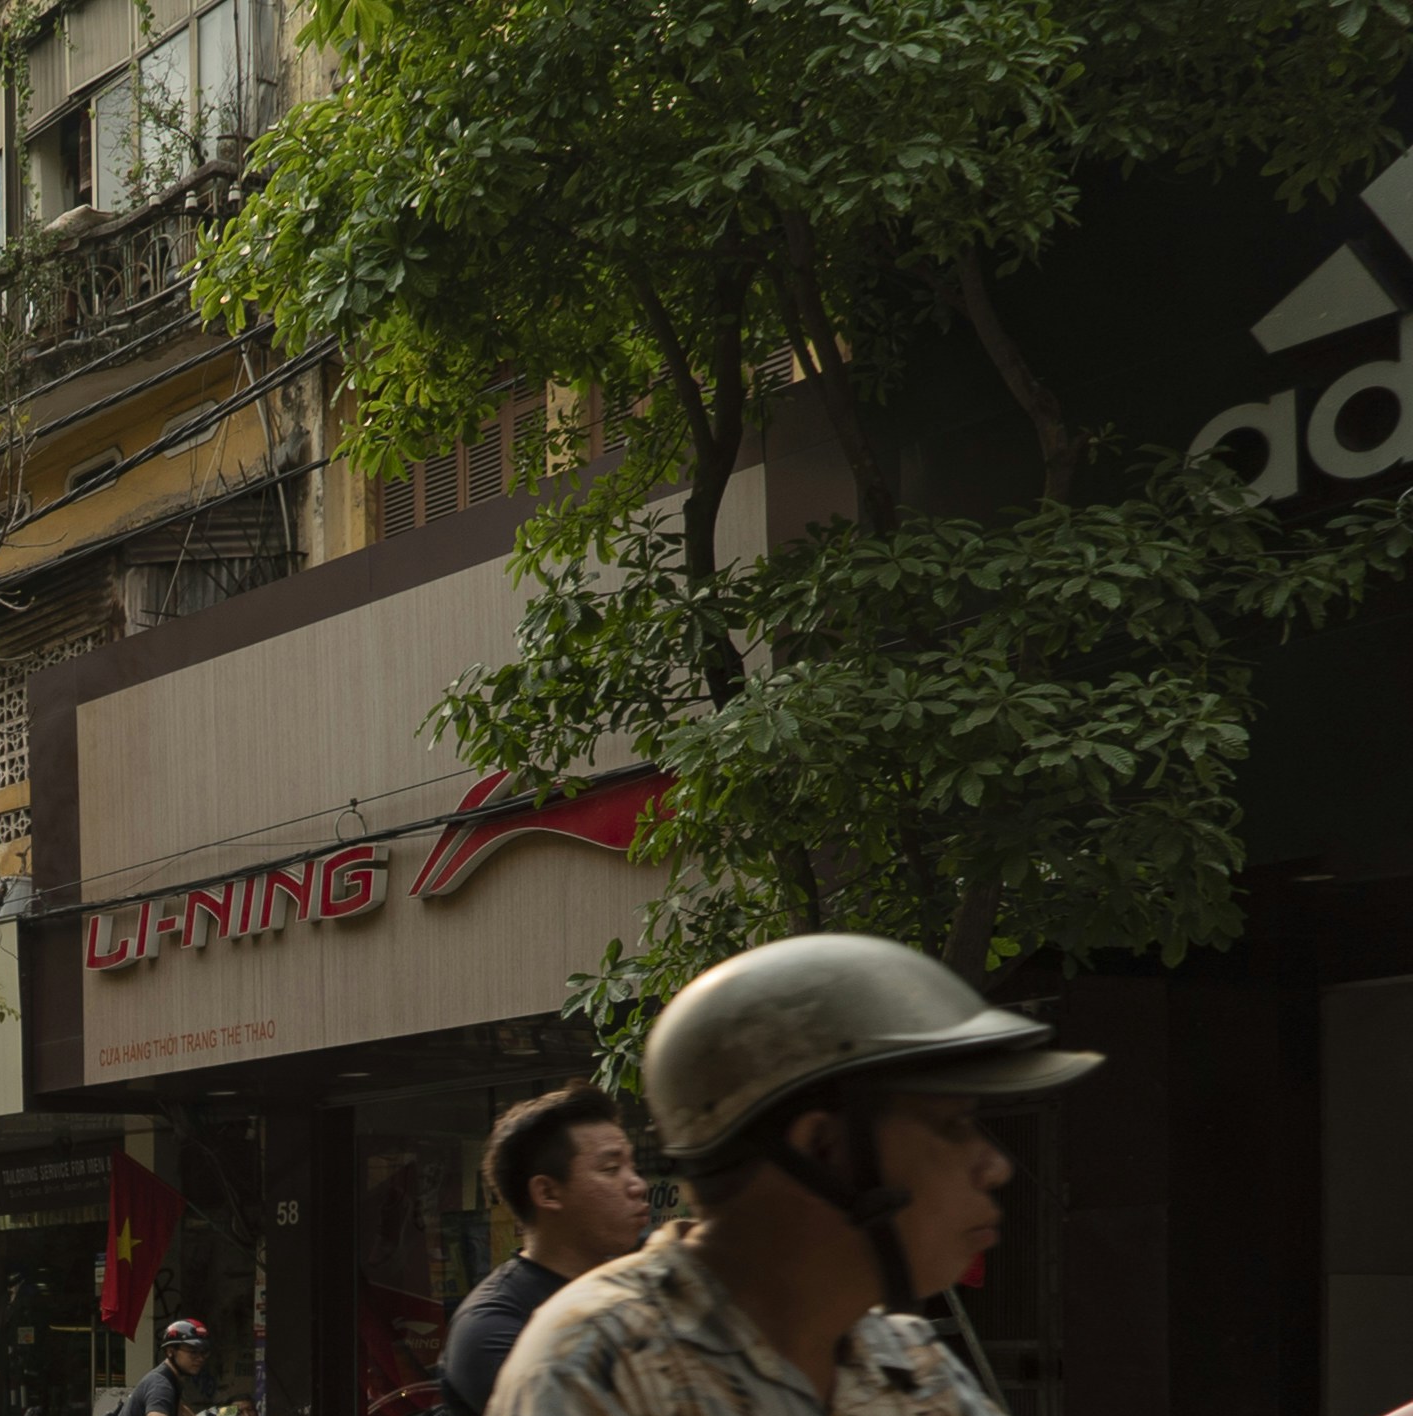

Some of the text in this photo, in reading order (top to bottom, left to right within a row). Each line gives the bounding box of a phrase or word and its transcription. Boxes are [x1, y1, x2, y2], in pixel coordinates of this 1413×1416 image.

[86, 845, 386, 971] LI-NING
[180, 1030, 218, 1053] TRANG
[244, 1020, 276, 1042] THAO
[39, 1162, 70, 1181] SERVICE
[70, 1159, 85, 1177] FOR
[86, 1157, 104, 1175] MEN
[276, 1200, 299, 1226] 58
